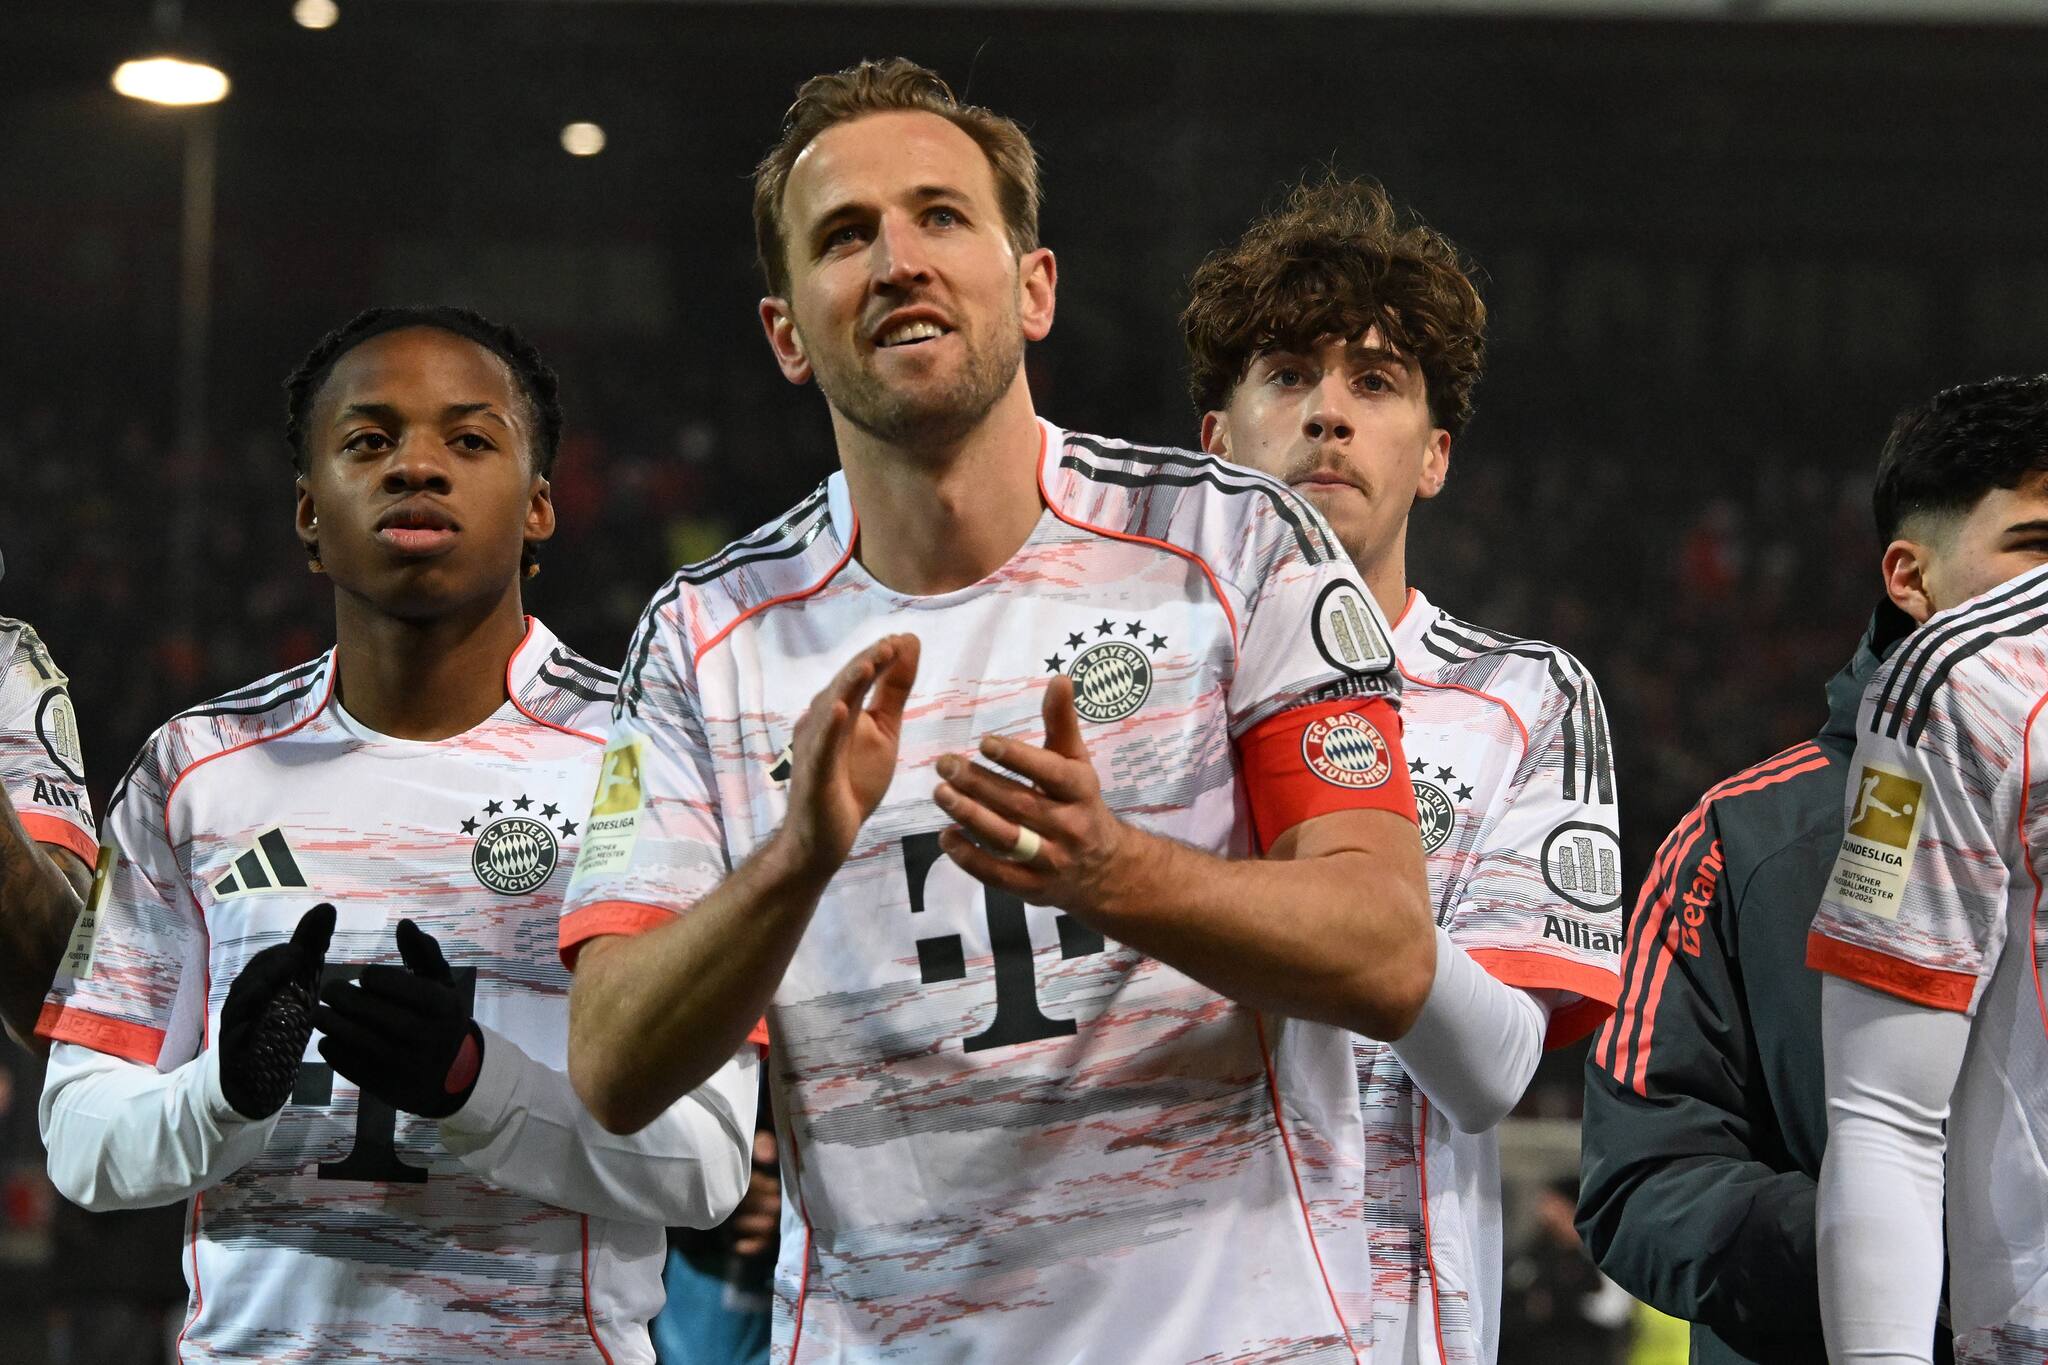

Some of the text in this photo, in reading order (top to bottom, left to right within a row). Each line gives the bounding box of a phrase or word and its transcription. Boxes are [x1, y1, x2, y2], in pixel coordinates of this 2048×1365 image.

[1072, 647, 1144, 682] FC BAYERN
[1308, 714, 1385, 750] FC BAYERN
[1412, 785, 1448, 815] YERN
[481, 821, 551, 851] FC BAYERN
[587, 817, 635, 834] NDESLIGA
[1842, 839, 1903, 867] BUNDESLIGA
[478, 860, 548, 890] MÜNCHEN
[1841, 869, 1881, 888] DEUTSCHER
